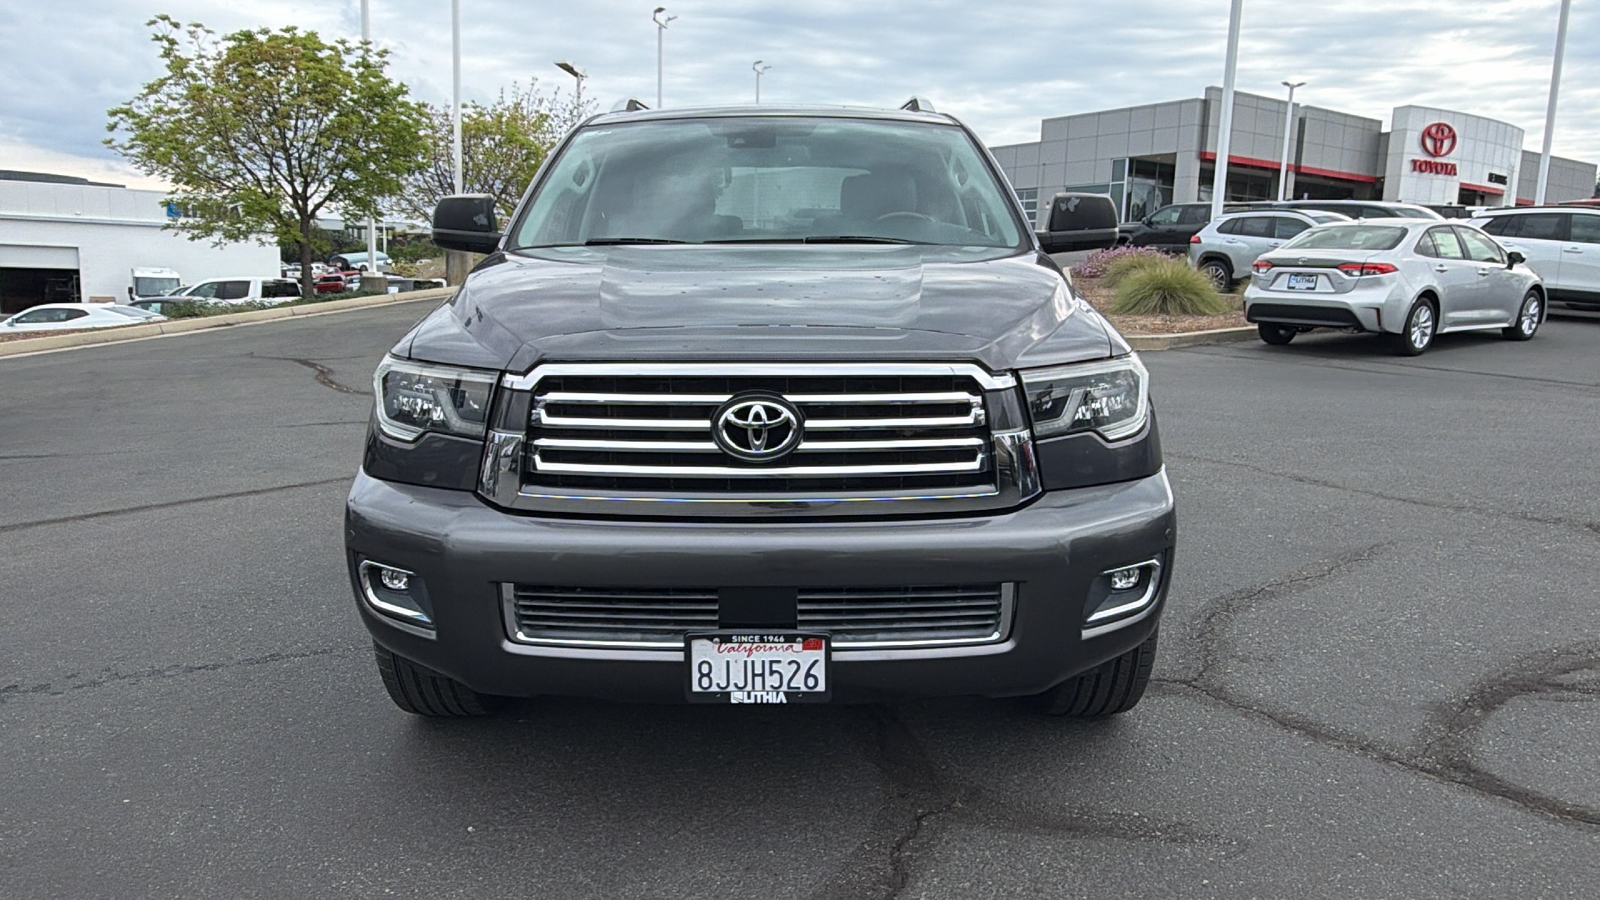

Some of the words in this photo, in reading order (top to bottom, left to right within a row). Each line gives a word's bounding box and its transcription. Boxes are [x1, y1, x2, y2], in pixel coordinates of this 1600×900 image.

[1411, 159, 1458, 176] TOYOTA
[731, 635, 760, 643] SINCE
[763, 635, 785, 643] 1946
[717, 642, 801, 658] California
[697, 659, 820, 691] 8JJH526
[743, 691, 788, 704] LITHIA
